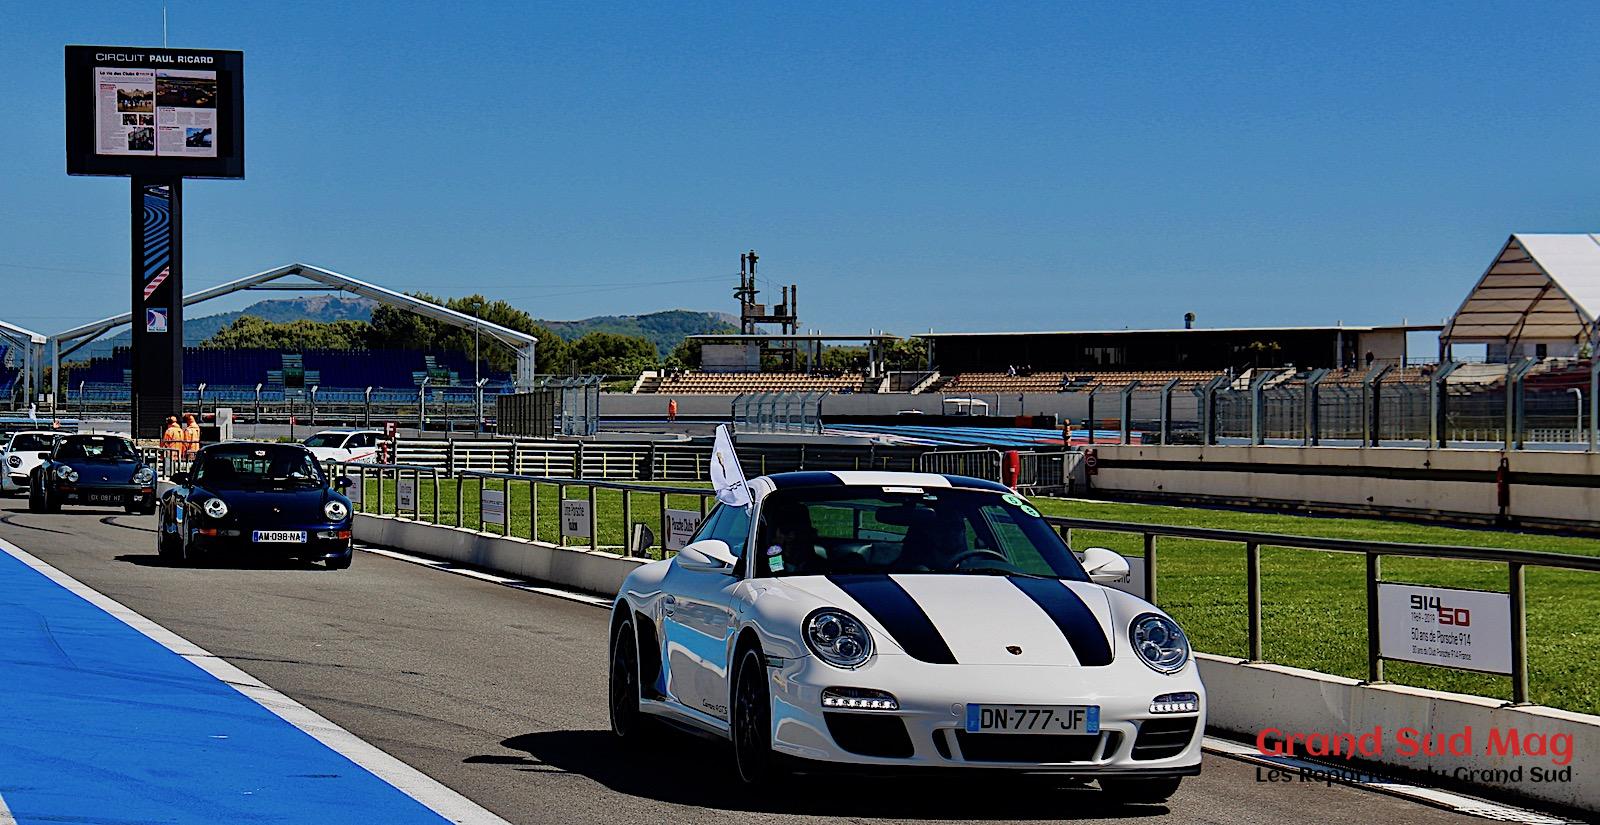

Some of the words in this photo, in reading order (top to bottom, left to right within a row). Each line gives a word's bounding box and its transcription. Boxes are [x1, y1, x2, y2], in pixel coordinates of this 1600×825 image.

[95, 53, 145, 62] CIRCUIT
[149, 55, 175, 63] PAUL
[177, 55, 214, 64] RICARD
[258, 532, 300, 541] AM-098-NA
[1410, 594, 1441, 611] 914
[1438, 607, 1470, 627] 50
[1411, 627, 1419, 641] 50
[1419, 630, 1429, 642] ans
[1429, 630, 1436, 643] de
[1436, 630, 1459, 646] Porsche
[1459, 632, 1472, 646] 914
[980, 708, 1085, 730] DN-777-JF
